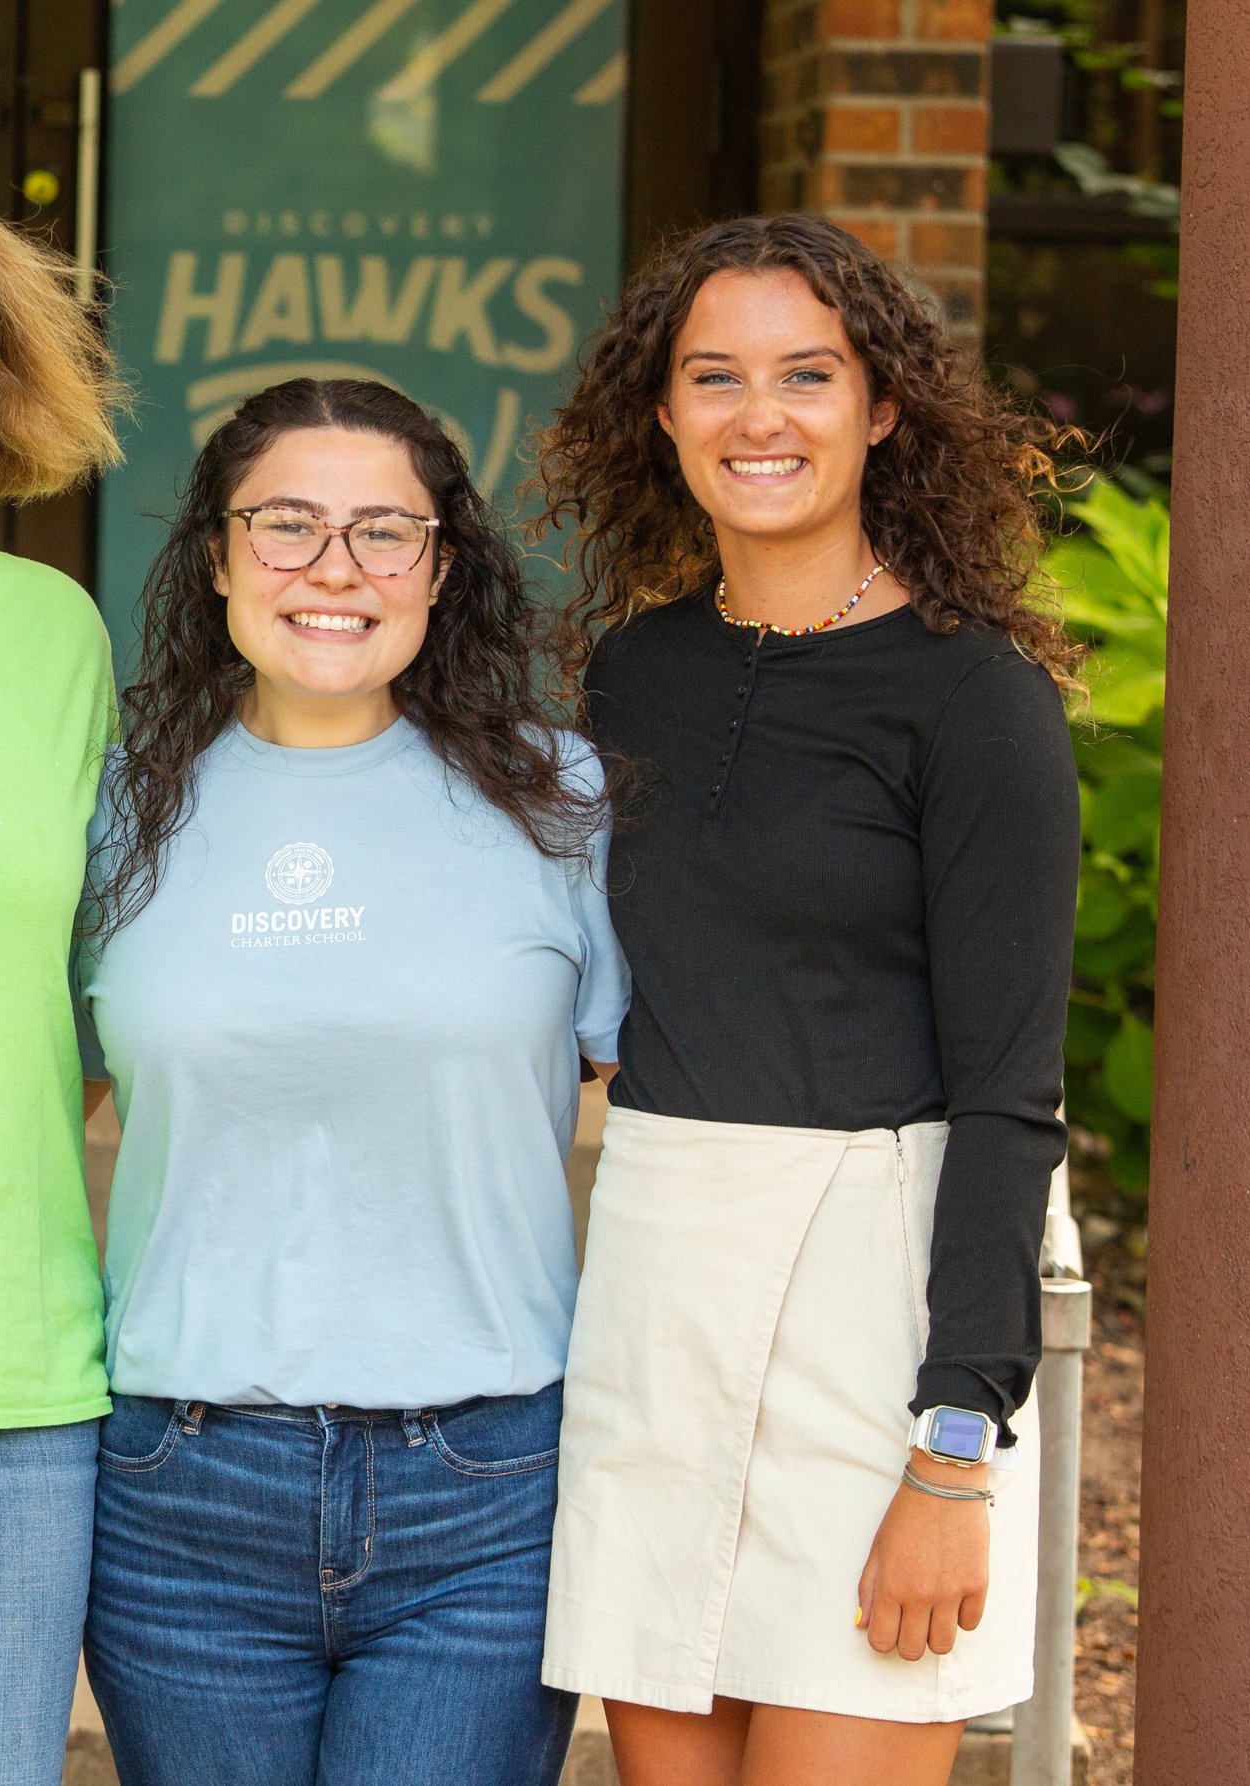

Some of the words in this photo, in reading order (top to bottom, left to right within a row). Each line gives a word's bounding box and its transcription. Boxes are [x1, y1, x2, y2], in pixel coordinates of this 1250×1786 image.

[223, 209, 493, 240] DISCOVERY
[155, 252, 584, 374] HAWKS
[231, 906, 366, 934] DISCOVERY
[230, 935, 301, 949] CHARTER
[305, 930, 367, 945] SCHOOL
